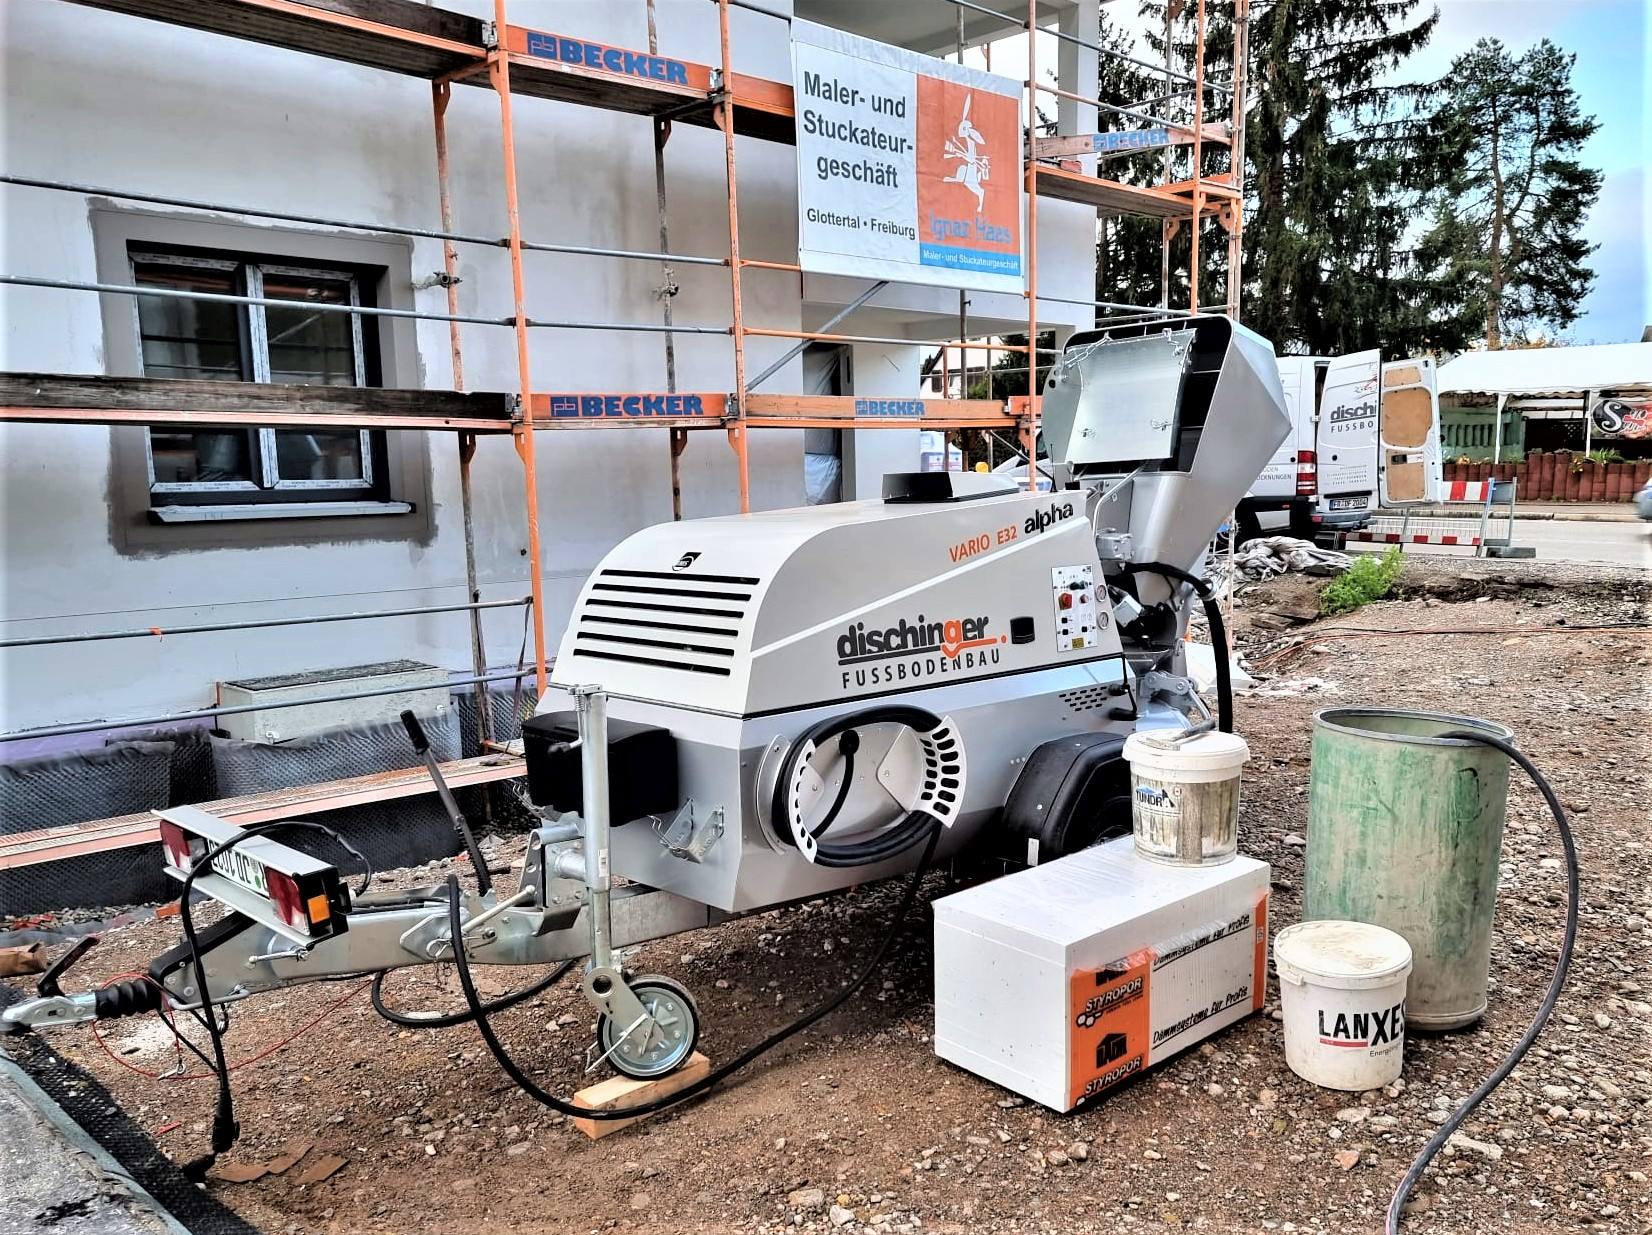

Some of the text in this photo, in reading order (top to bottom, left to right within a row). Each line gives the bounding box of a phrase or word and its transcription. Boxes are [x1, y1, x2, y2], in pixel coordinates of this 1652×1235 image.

[559, 38, 688, 86] BECKER
[804, 71, 906, 119] Maler- und
[803, 109, 914, 154] Stuckateur-
[817, 155, 898, 188] geschäft
[807, 208, 916, 241] Glottertal Freiburg
[946, 253, 958, 263] und
[581, 395, 704, 417] BECKER
[868, 400, 926, 415] BECKER
[1331, 421, 1374, 433] FUSSBO
[949, 502, 1074, 563] VARIO E32 alpha
[837, 614, 989, 659] dischinger
[842, 648, 1000, 689] FUSSBODENBAU
[1085, 976, 1144, 1013] STYROPOR
[1085, 1055, 1143, 1095] STYROPOR
